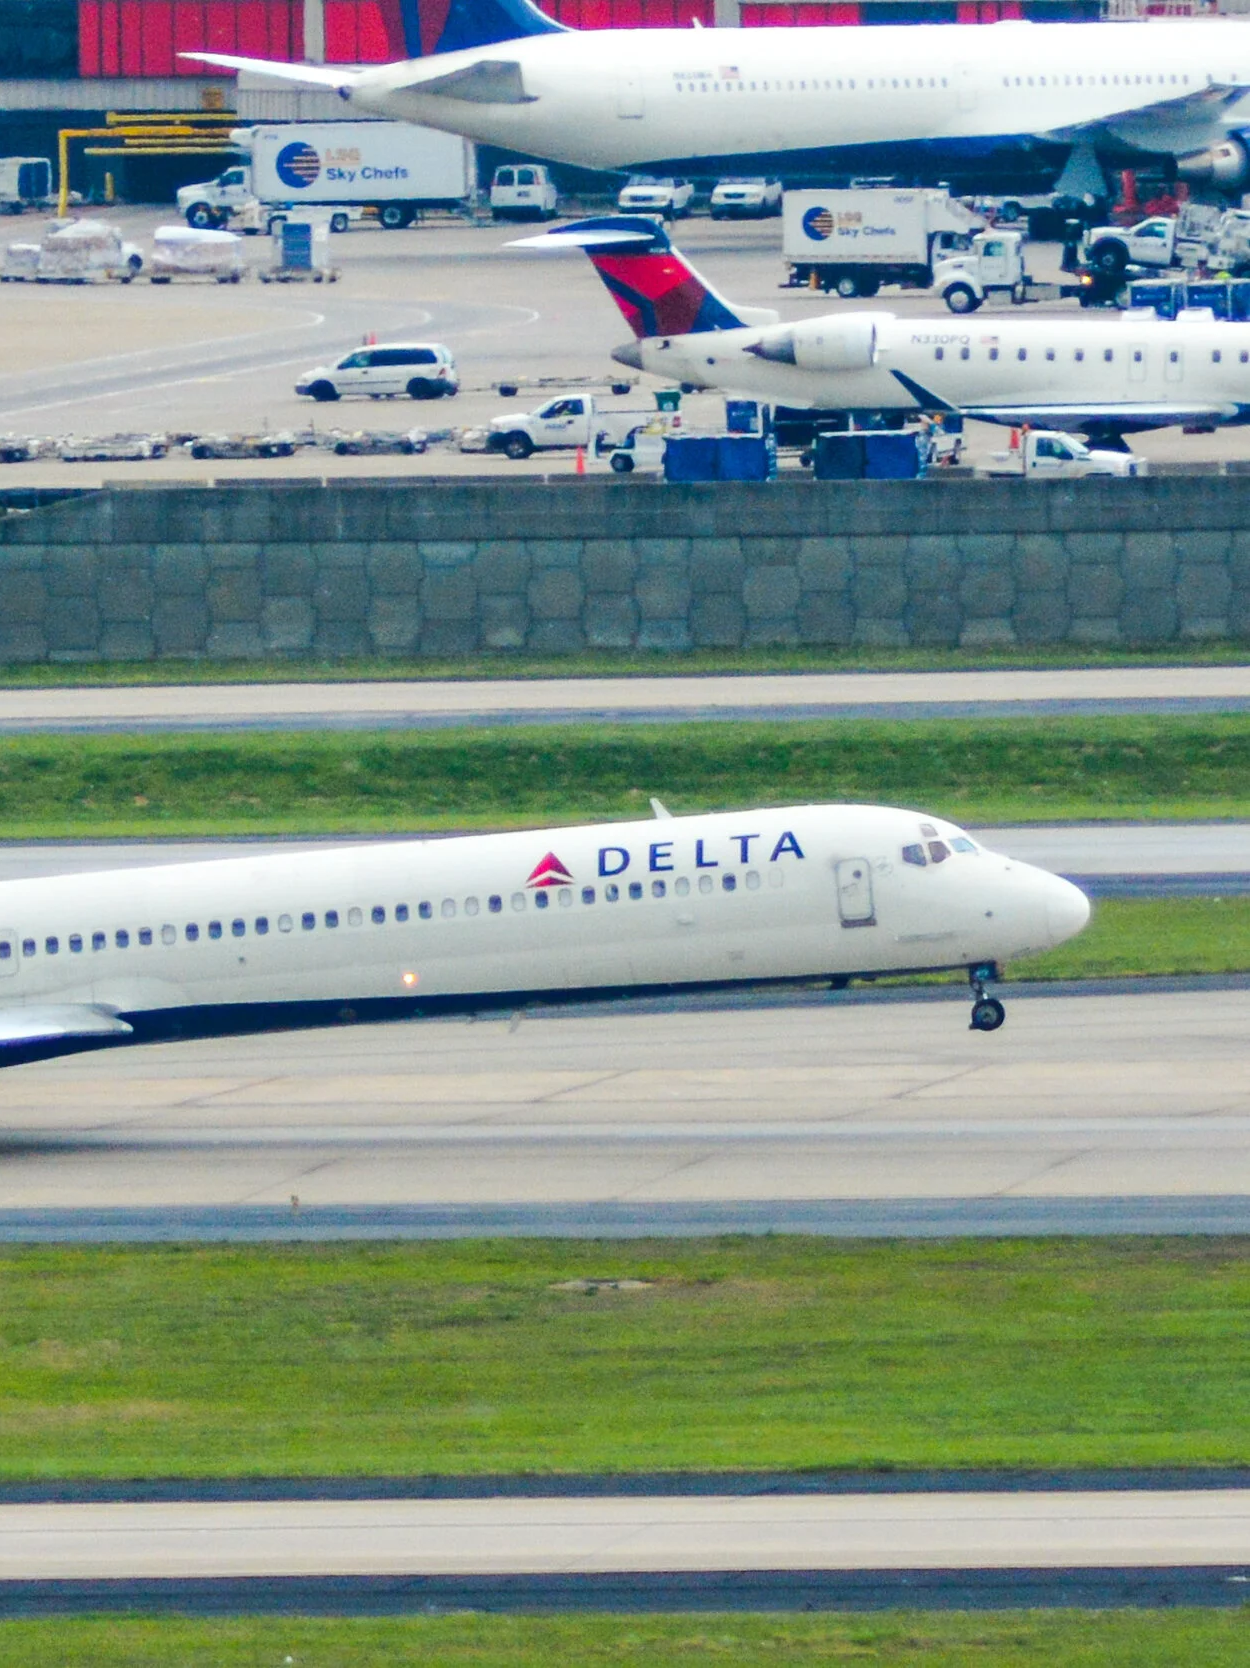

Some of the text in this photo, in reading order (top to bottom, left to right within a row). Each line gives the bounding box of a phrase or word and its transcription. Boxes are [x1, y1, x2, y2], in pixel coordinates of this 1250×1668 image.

[327, 166, 409, 182] Sky Chefs
[598, 831, 805, 877] DELTA
